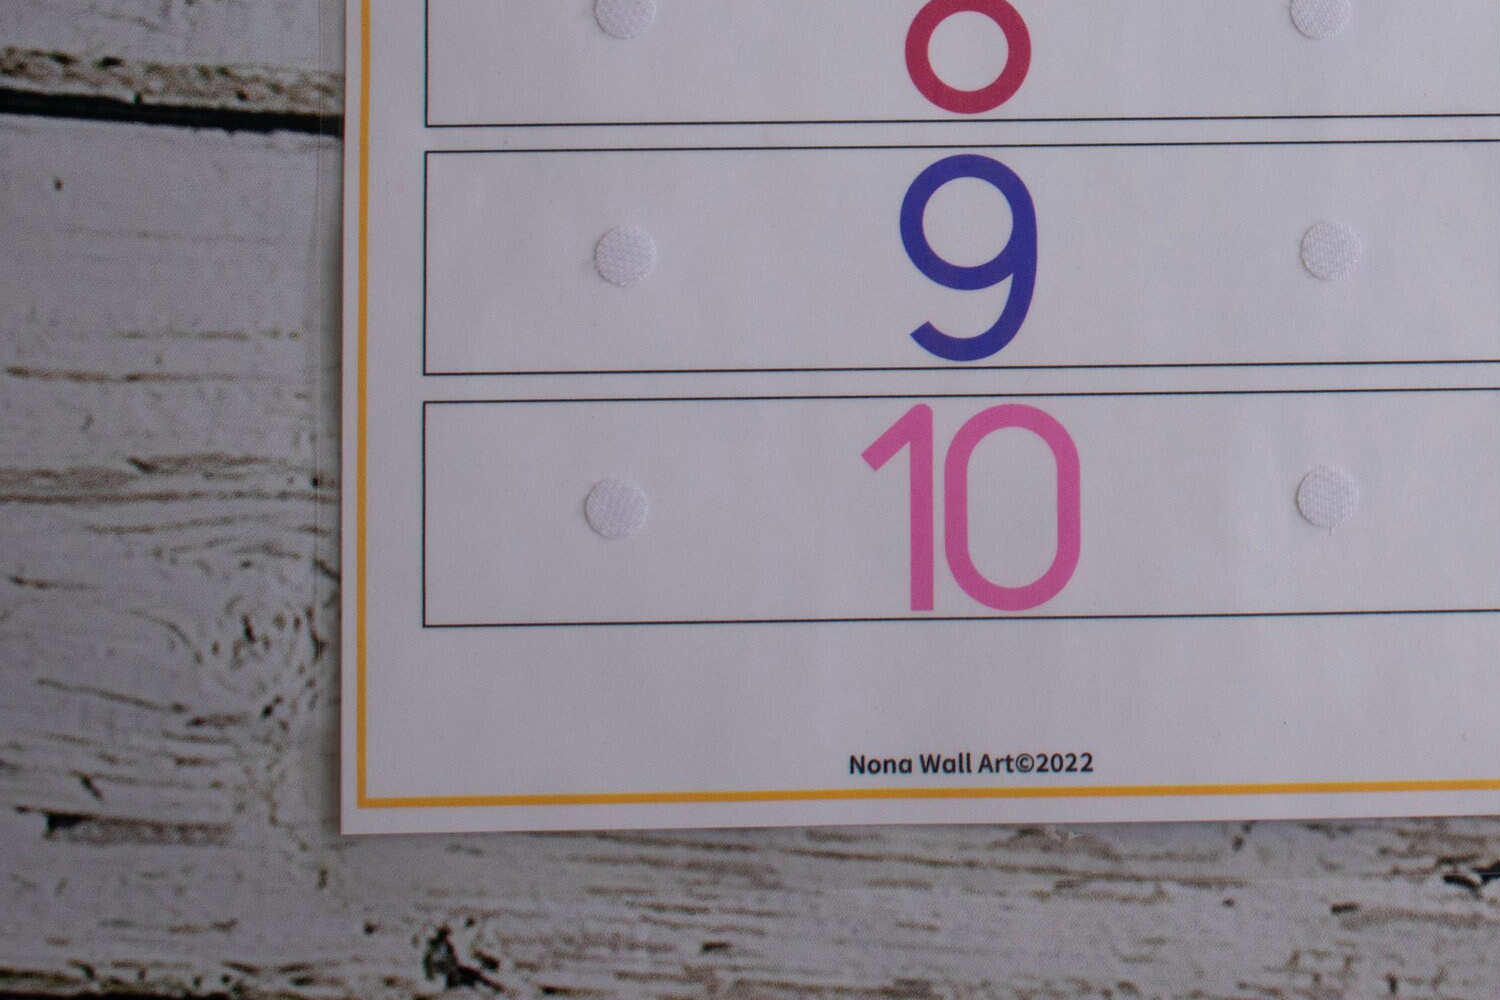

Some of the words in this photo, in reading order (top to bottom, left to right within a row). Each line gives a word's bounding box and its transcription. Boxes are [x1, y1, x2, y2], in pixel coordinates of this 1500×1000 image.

[899, 153, 1038, 362] 9
[861, 403, 1081, 611] 10
[849, 754, 913, 775] Nona
[919, 752, 972, 774] Wall
